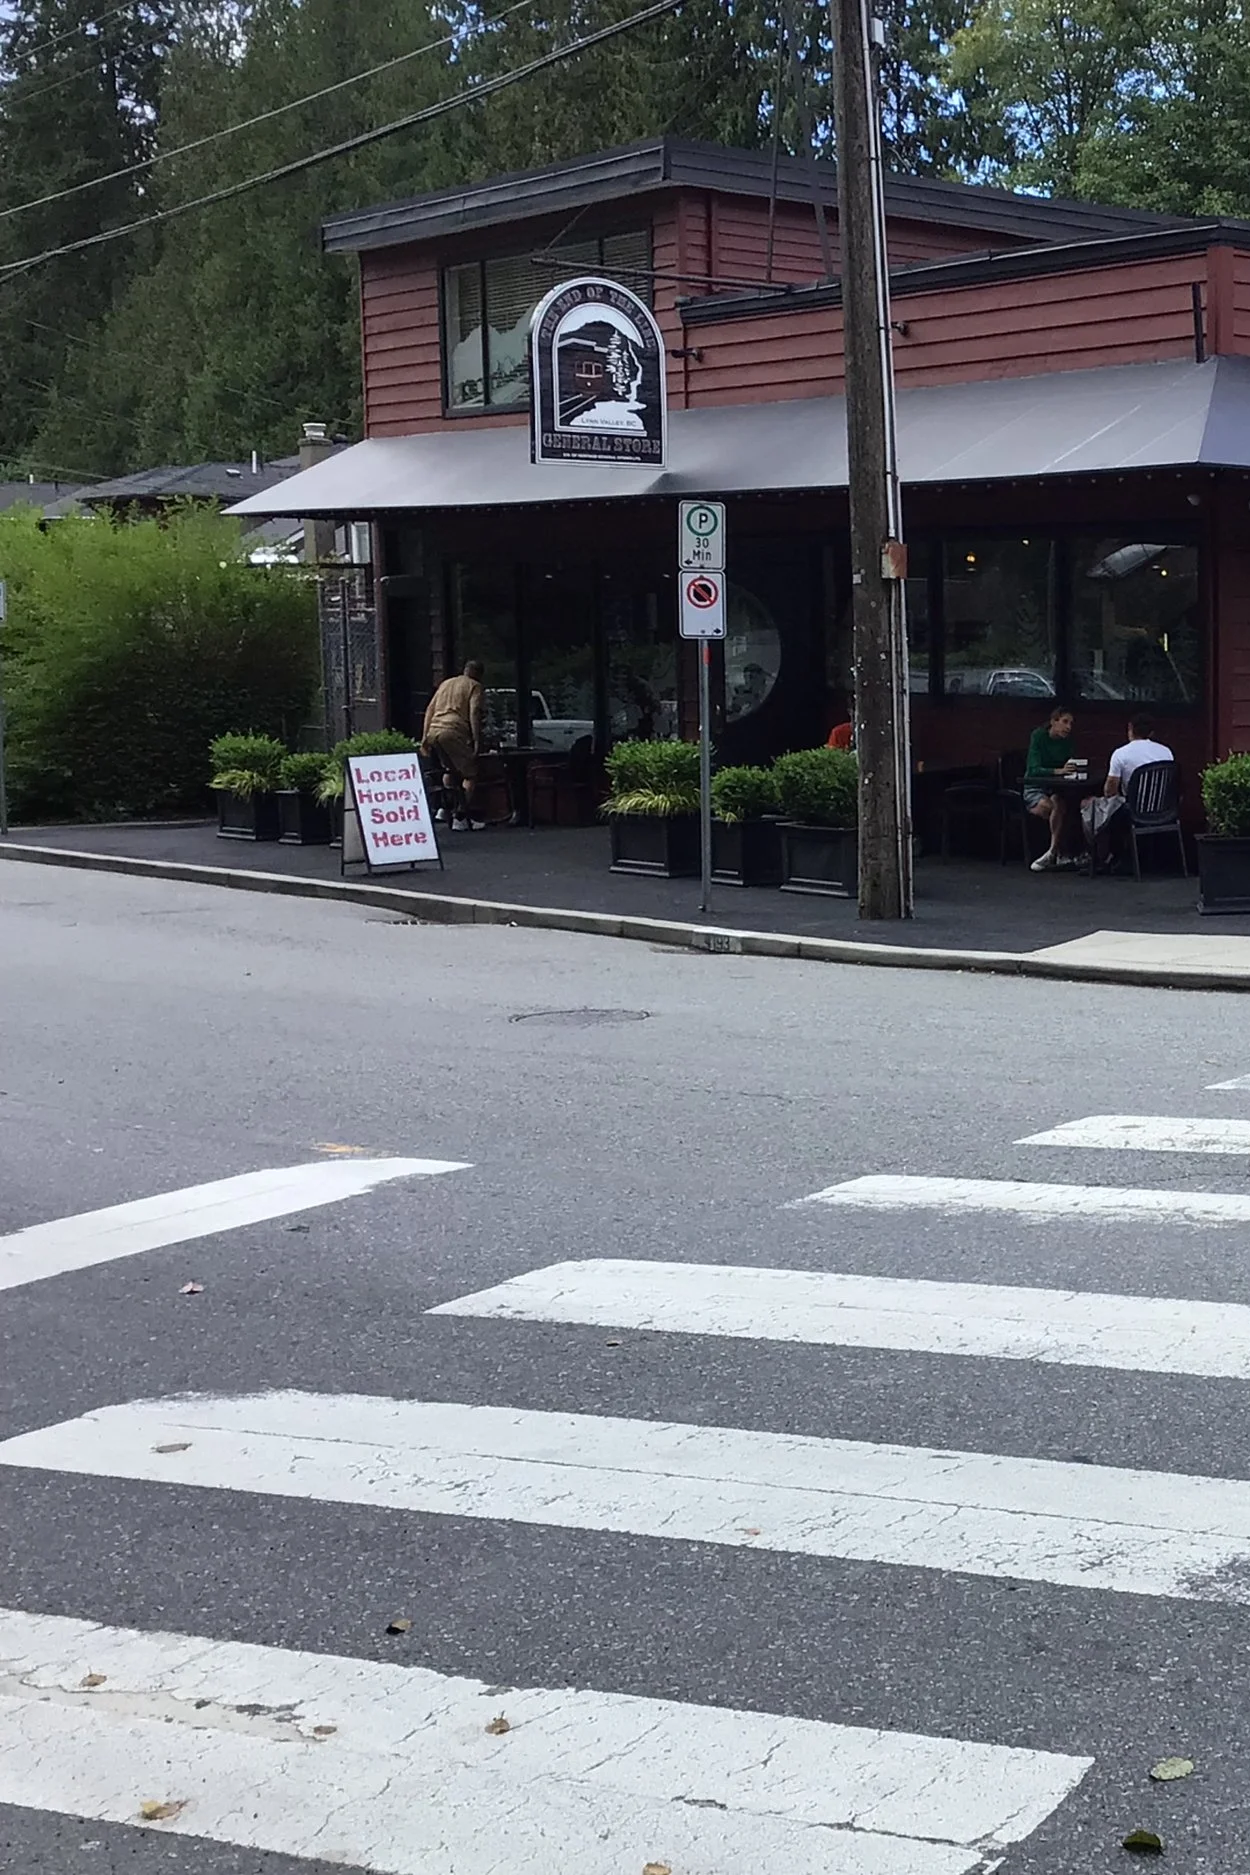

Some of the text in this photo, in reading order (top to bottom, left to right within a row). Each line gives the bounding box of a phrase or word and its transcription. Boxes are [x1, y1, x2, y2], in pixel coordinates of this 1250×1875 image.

[541, 287, 656, 348] THE END OF THE LINE
[543, 433, 660, 454] GENERAL STORE
[699, 513, 709, 529] P
[695, 537, 710, 548] 30
[692, 549, 712, 561] Min
[354, 764, 417, 784] Local
[357, 788, 422, 804] Honey
[371, 805, 421, 824] Sold
[371, 831, 427, 848] Here
